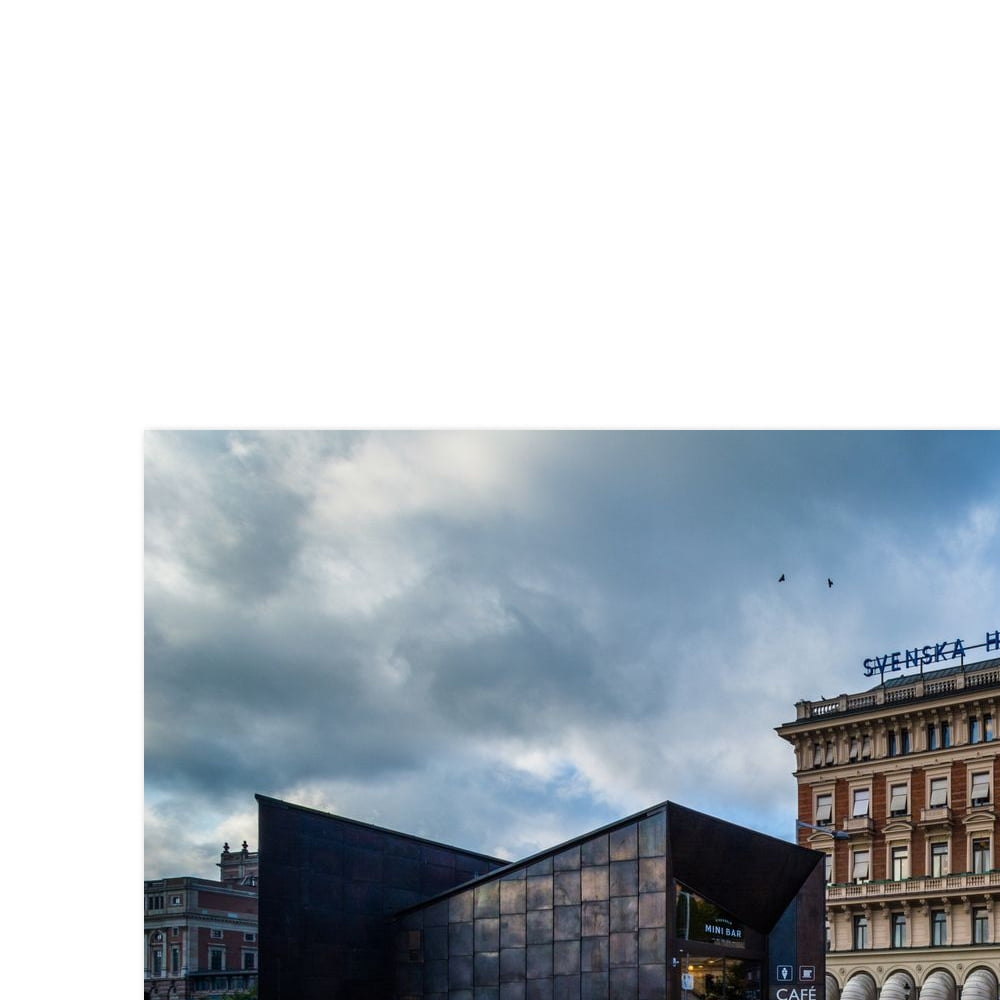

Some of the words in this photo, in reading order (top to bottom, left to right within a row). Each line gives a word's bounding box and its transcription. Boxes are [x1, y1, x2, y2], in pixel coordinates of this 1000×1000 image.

[863, 638, 965, 678] SVENSKA
[705, 924, 724, 935] MINI
[725, 928, 742, 938] BAR
